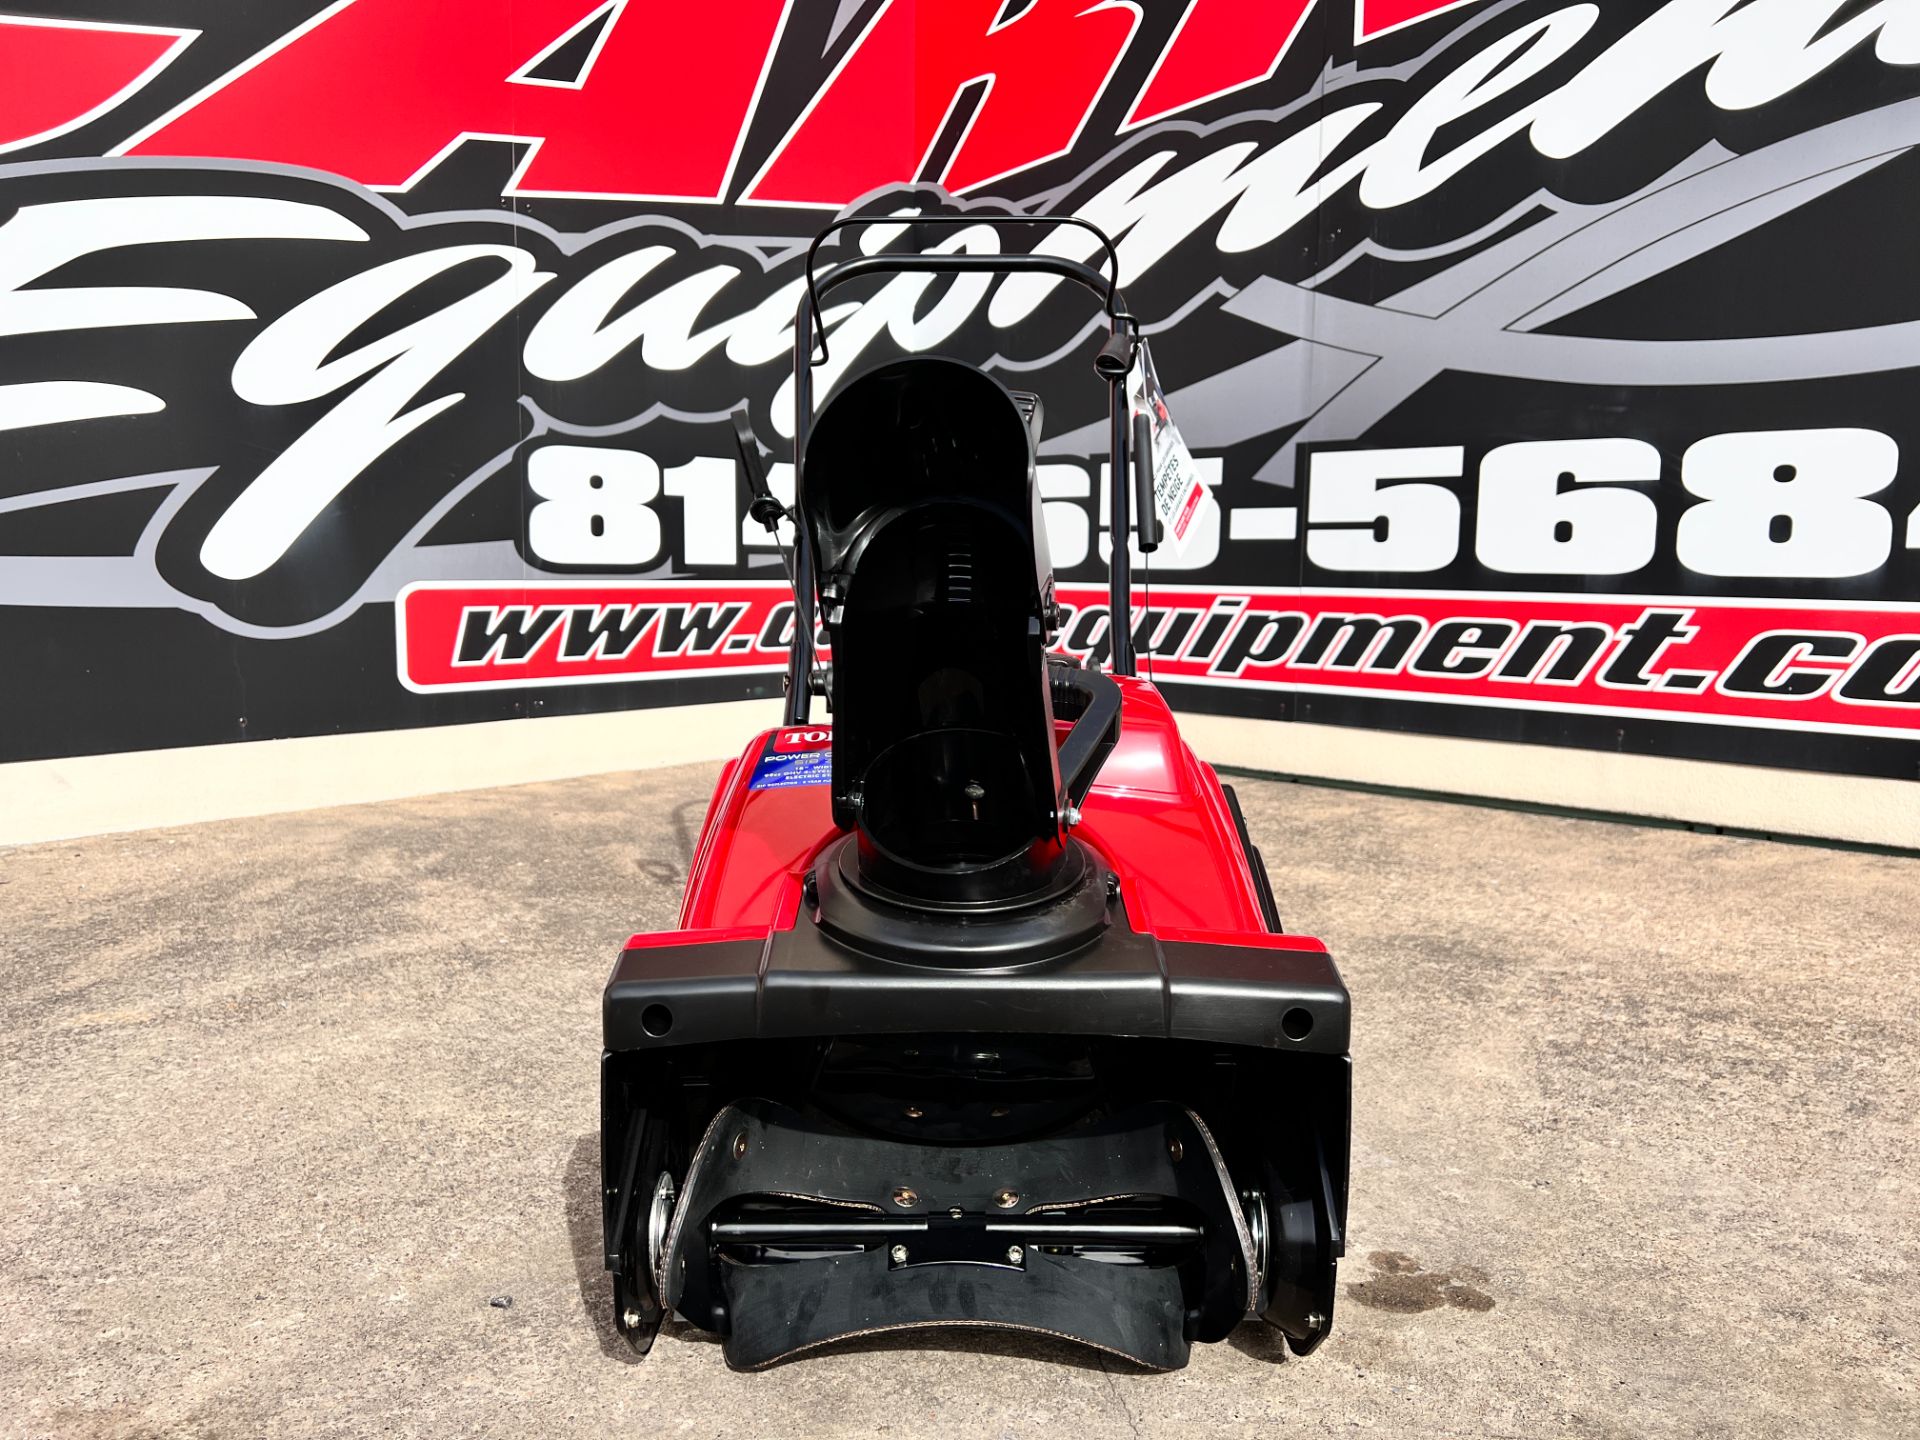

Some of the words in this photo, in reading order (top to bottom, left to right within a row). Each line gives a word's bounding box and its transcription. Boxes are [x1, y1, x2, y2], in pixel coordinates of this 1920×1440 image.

[1161, 501, 1171, 516] DE
[1167, 473, 1183, 504] NEIGE
[764, 752, 820, 763] POWER
